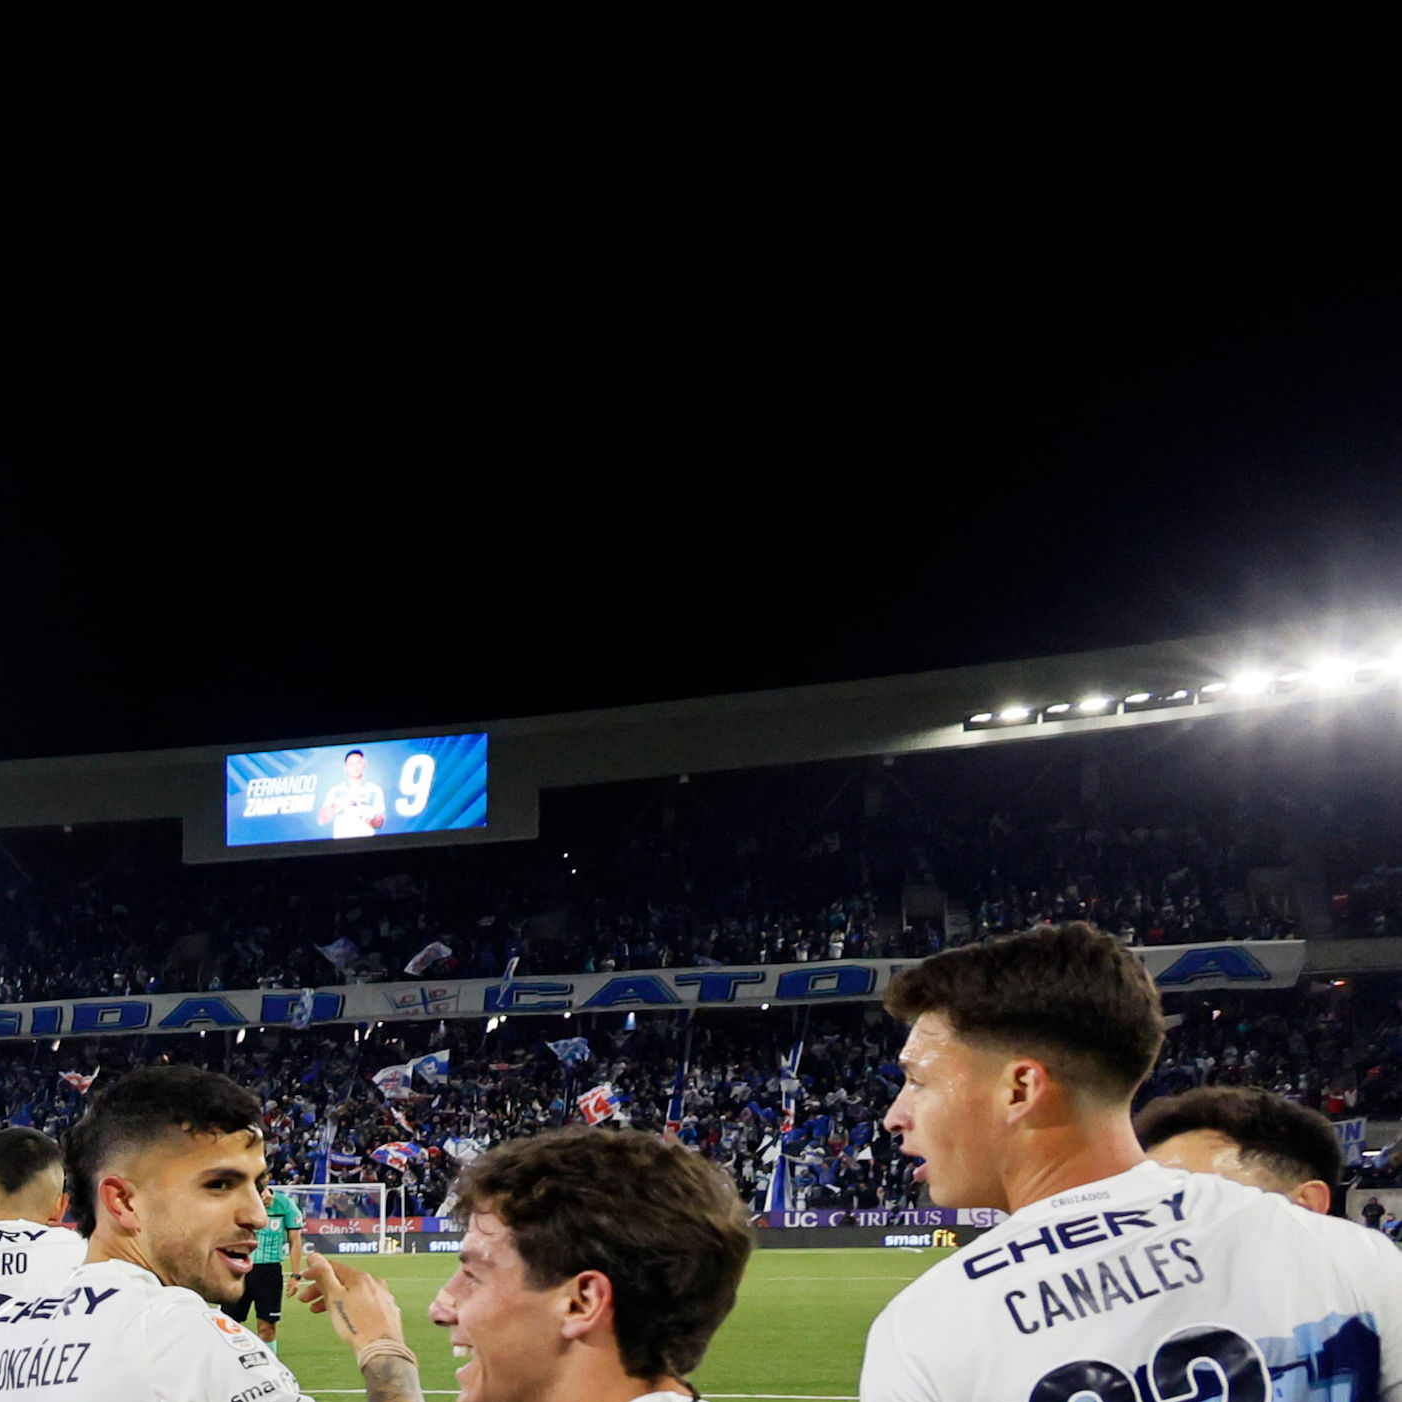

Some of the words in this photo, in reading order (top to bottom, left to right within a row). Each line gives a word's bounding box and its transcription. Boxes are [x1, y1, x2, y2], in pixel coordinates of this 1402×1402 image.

[395, 753, 435, 817] 9
[784, 1211, 818, 1228] UC
[962, 1190, 1188, 1281] CHERY
[1004, 1237, 1206, 1336] CANALES
